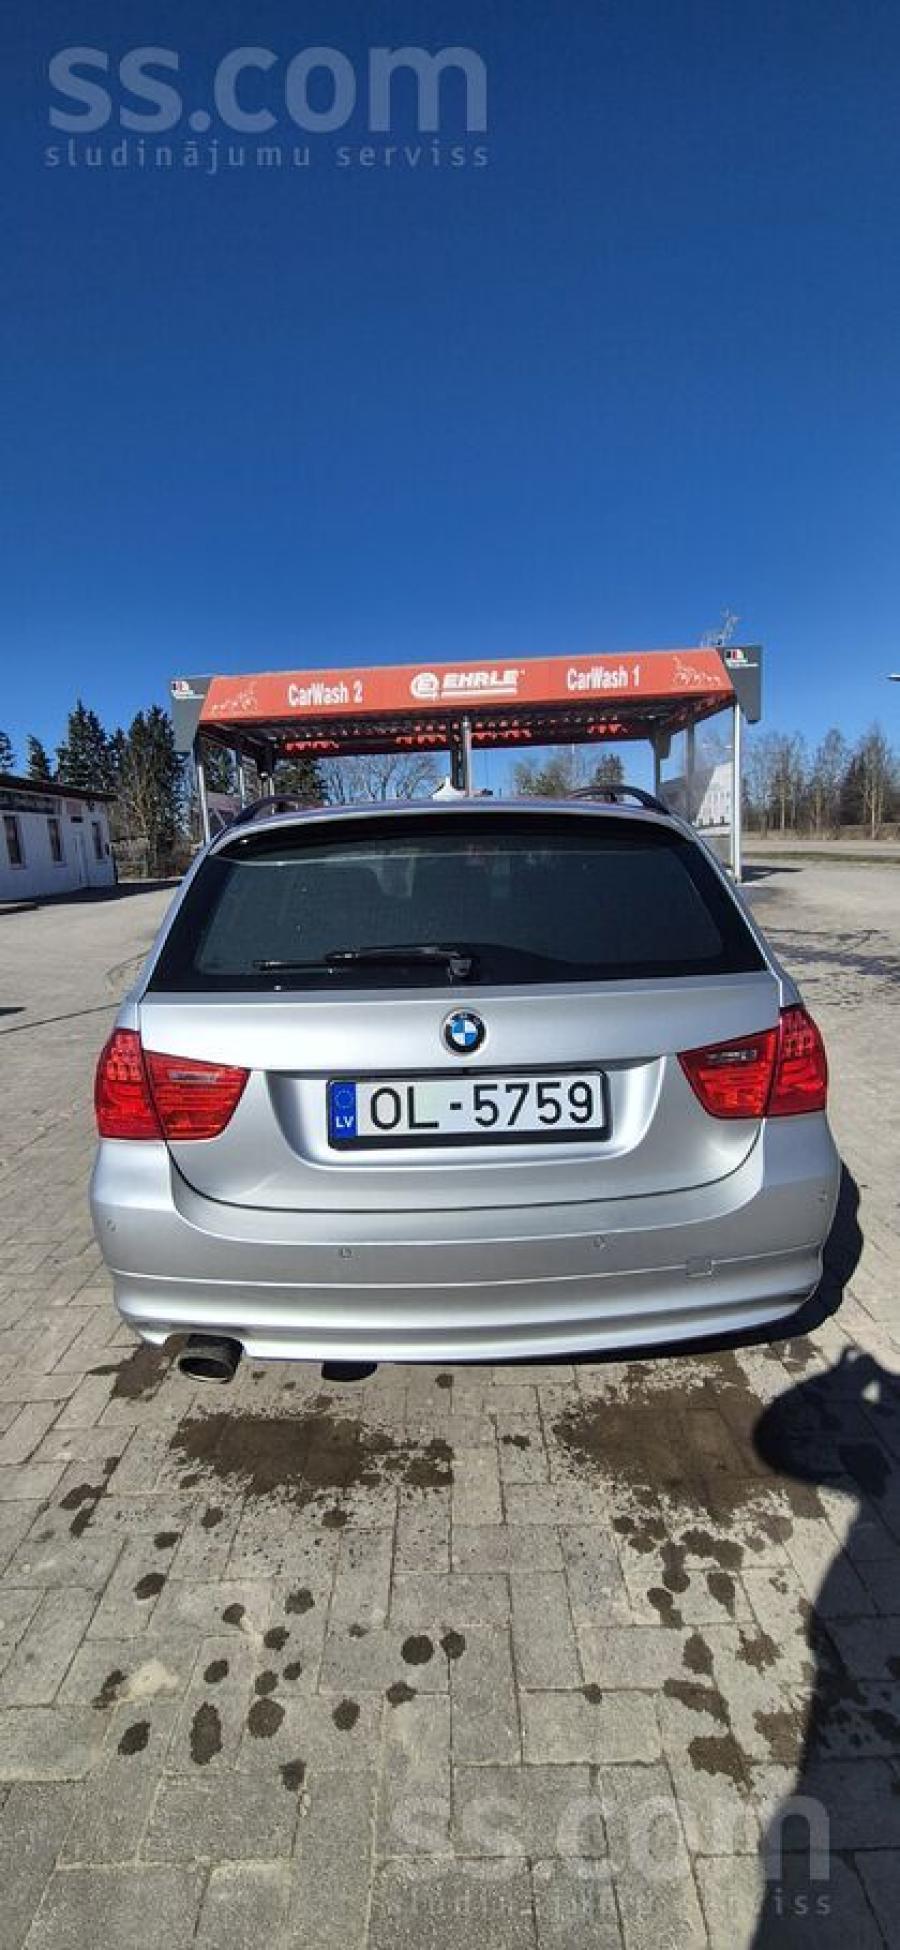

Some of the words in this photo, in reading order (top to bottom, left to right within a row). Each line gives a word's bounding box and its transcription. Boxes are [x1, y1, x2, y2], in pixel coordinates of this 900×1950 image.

[443, 670, 518, 688] EHRLE
[567, 665, 628, 690] CarWash
[632, 663, 640, 687] 1
[288, 682, 348, 706] CarWash
[353, 680, 363, 703] 2
[335, 1116, 355, 1128] LV
